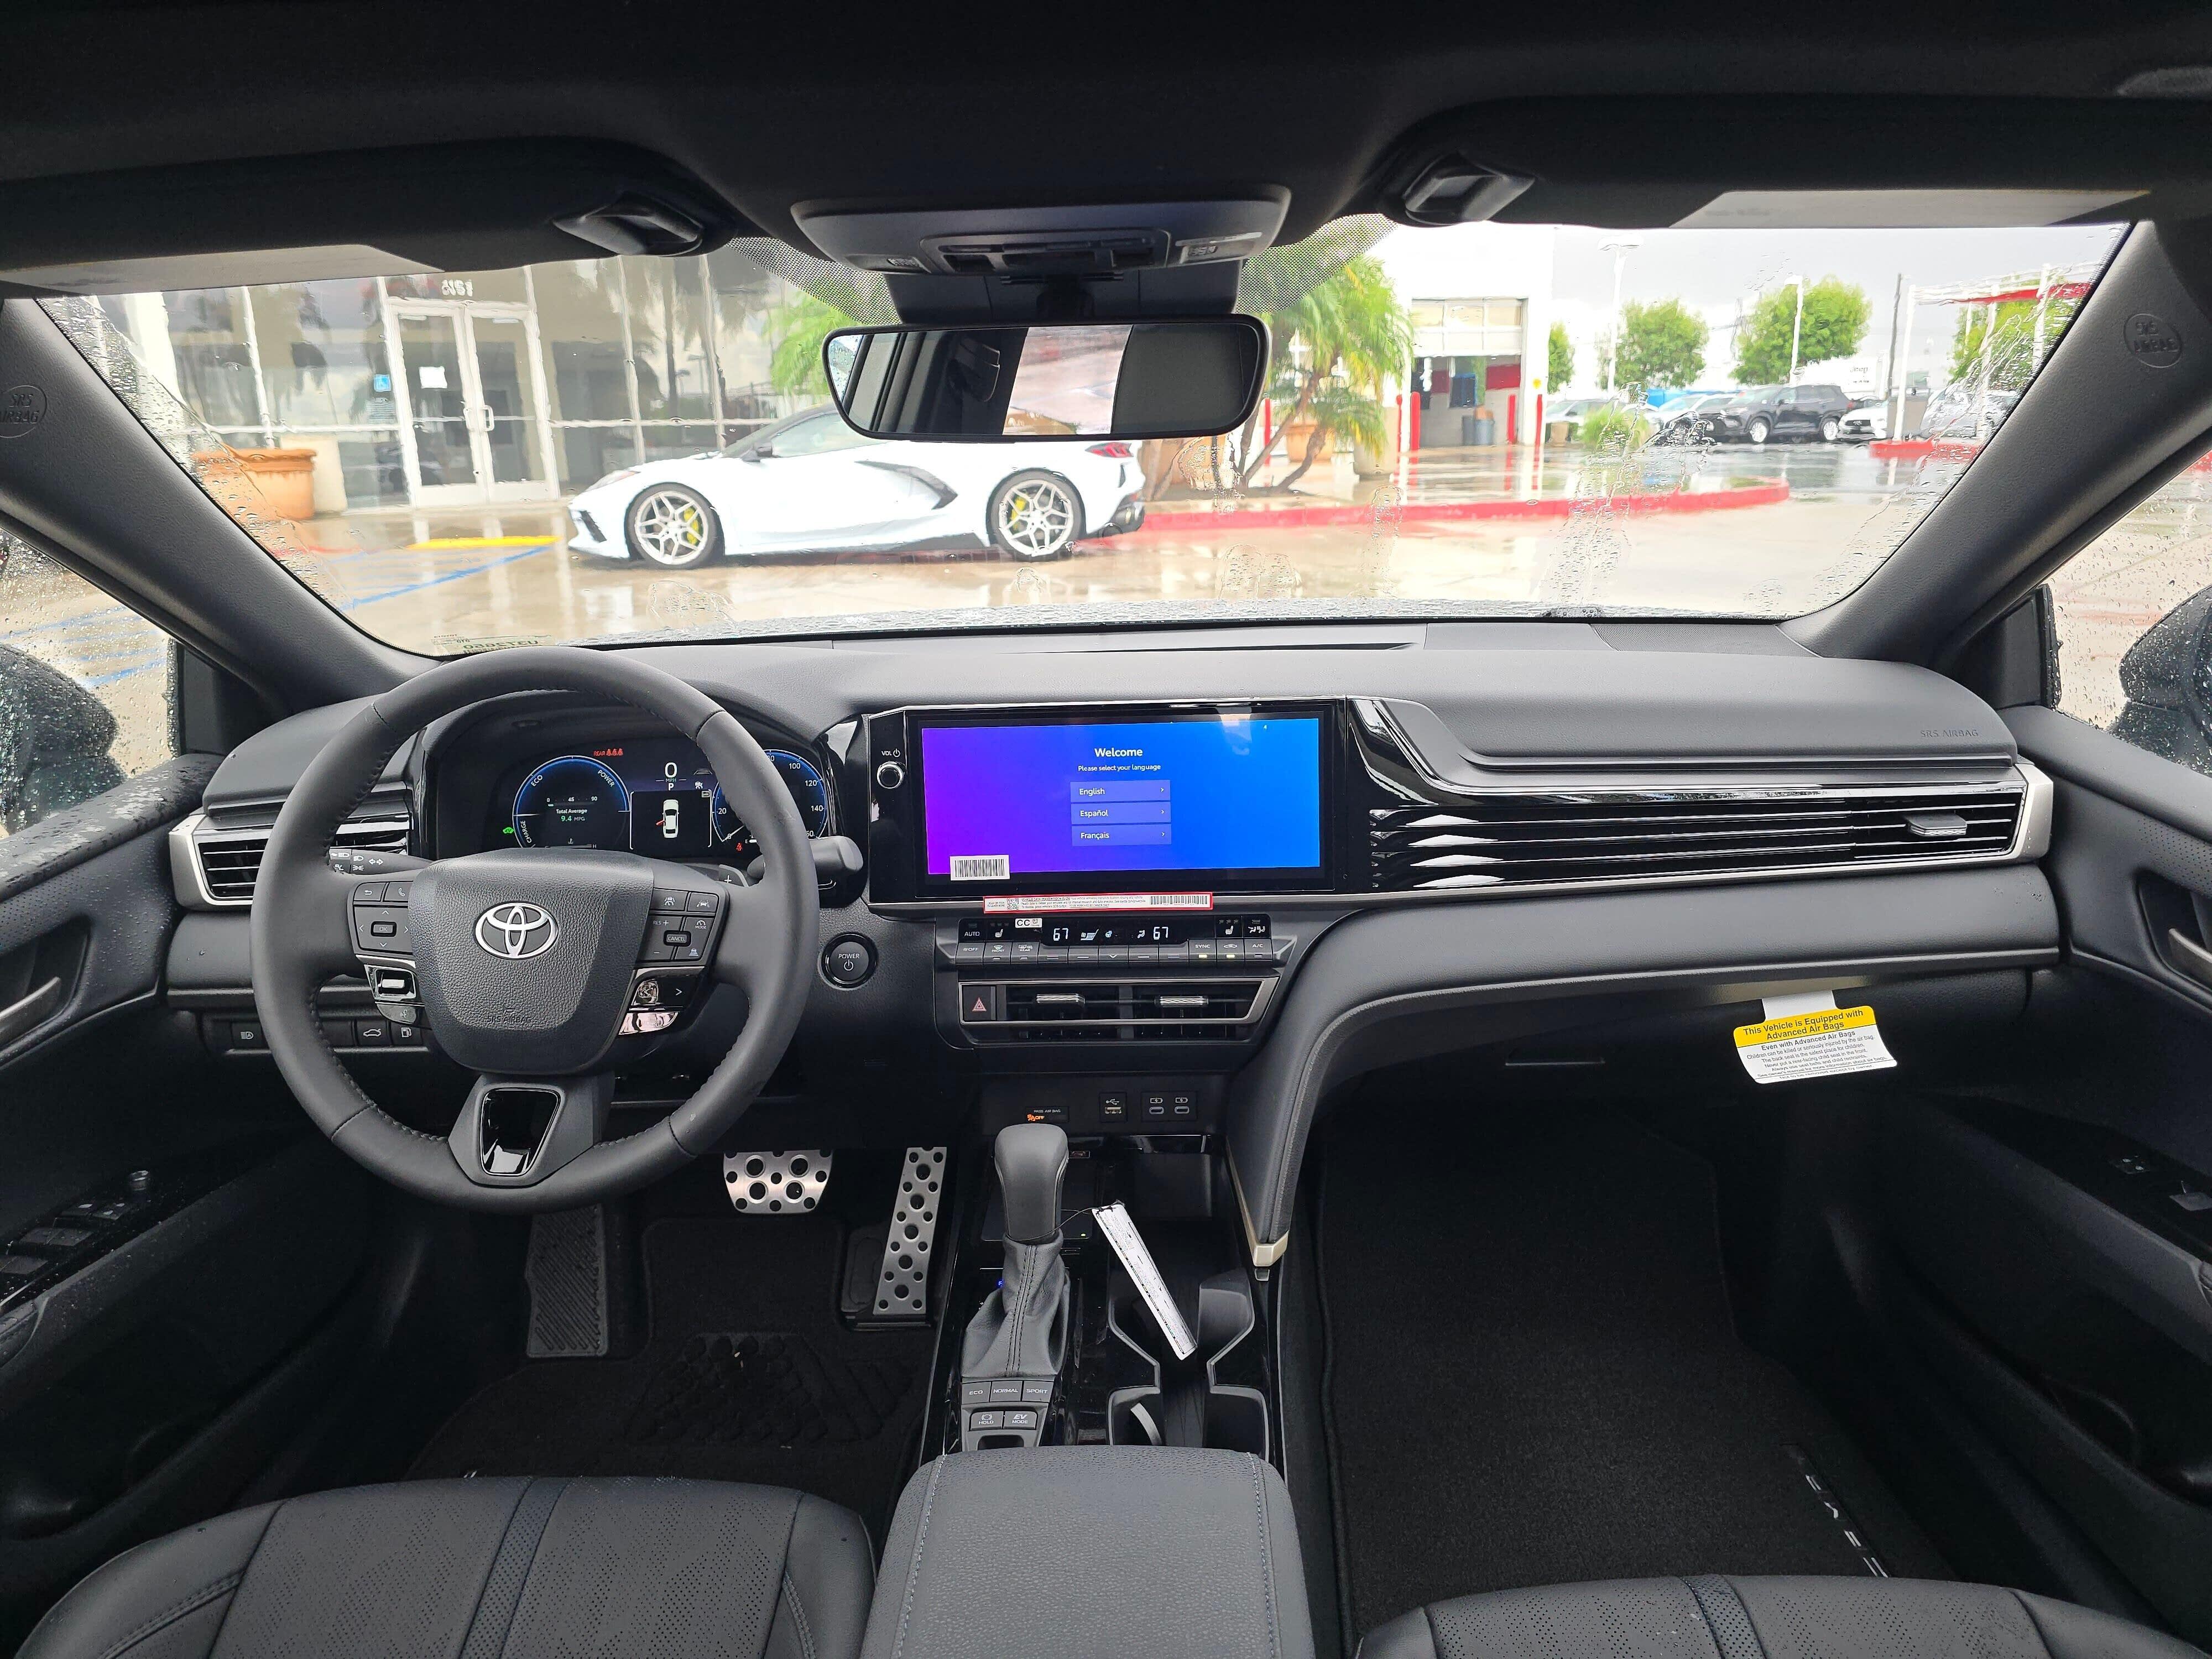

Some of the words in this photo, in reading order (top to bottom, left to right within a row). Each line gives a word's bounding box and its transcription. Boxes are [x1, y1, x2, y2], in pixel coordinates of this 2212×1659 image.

[9, 393, 34, 408] SRS
[1094, 748, 1143, 757] Welcome
[665, 762, 677, 778] 0
[1132, 764, 1161, 772] language
[530, 775, 543, 787] ECO
[597, 769, 615, 787] POWER
[668, 782, 674, 791] P
[1079, 787, 1105, 796] English
[1080, 810, 1108, 818] Español
[520, 820, 532, 844] CHARGE
[1081, 832, 1109, 840] Français
[1053, 928, 1068, 941] 67
[1153, 926, 1168, 940] 67
[1743, 1027, 1761, 1036] This
[1763, 1021, 1793, 1032] Vehicle
[1804, 1012, 1844, 1027] Equipped
[1845, 1009, 1864, 1018] with
[1767, 1026, 1807, 1040] Advanced
[1823, 1021, 1844, 1030] Bags
[1794, 1035, 1827, 1045] Advanced
[1803, 1042, 1824, 1051] seriously
